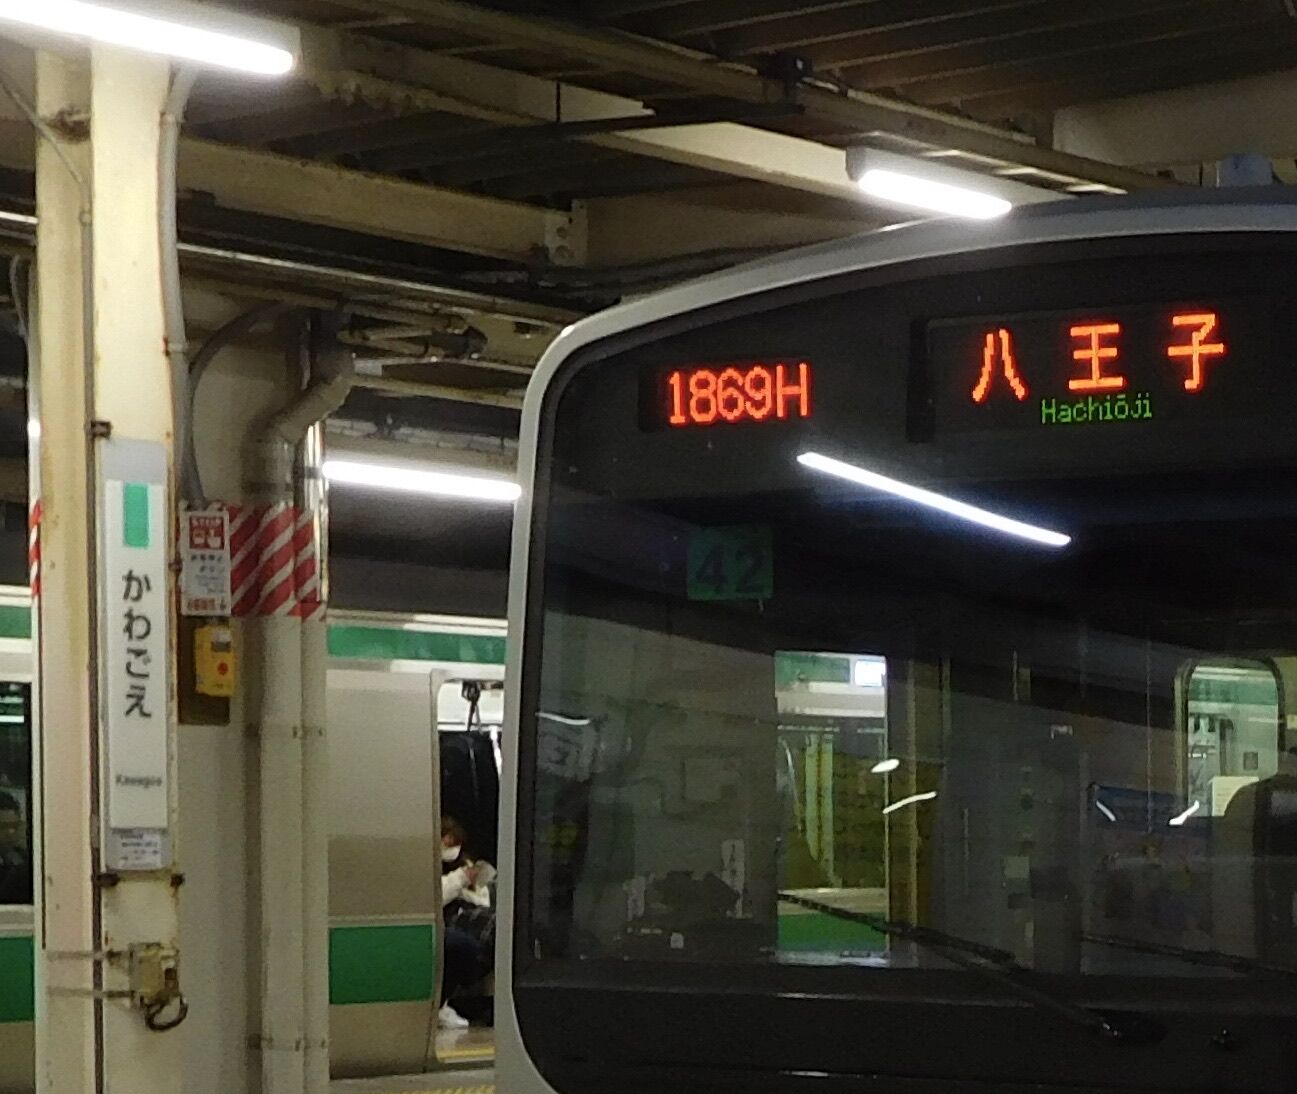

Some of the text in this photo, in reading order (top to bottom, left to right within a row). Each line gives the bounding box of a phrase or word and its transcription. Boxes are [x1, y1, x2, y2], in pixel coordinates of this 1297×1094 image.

[971, 312, 1225, 402] 八王子
[668, 363, 810, 425] 1869H
[1041, 392, 1153, 425] Hachiōji
[696, 544, 766, 595] 42
[122, 569, 152, 718] かわごえ
